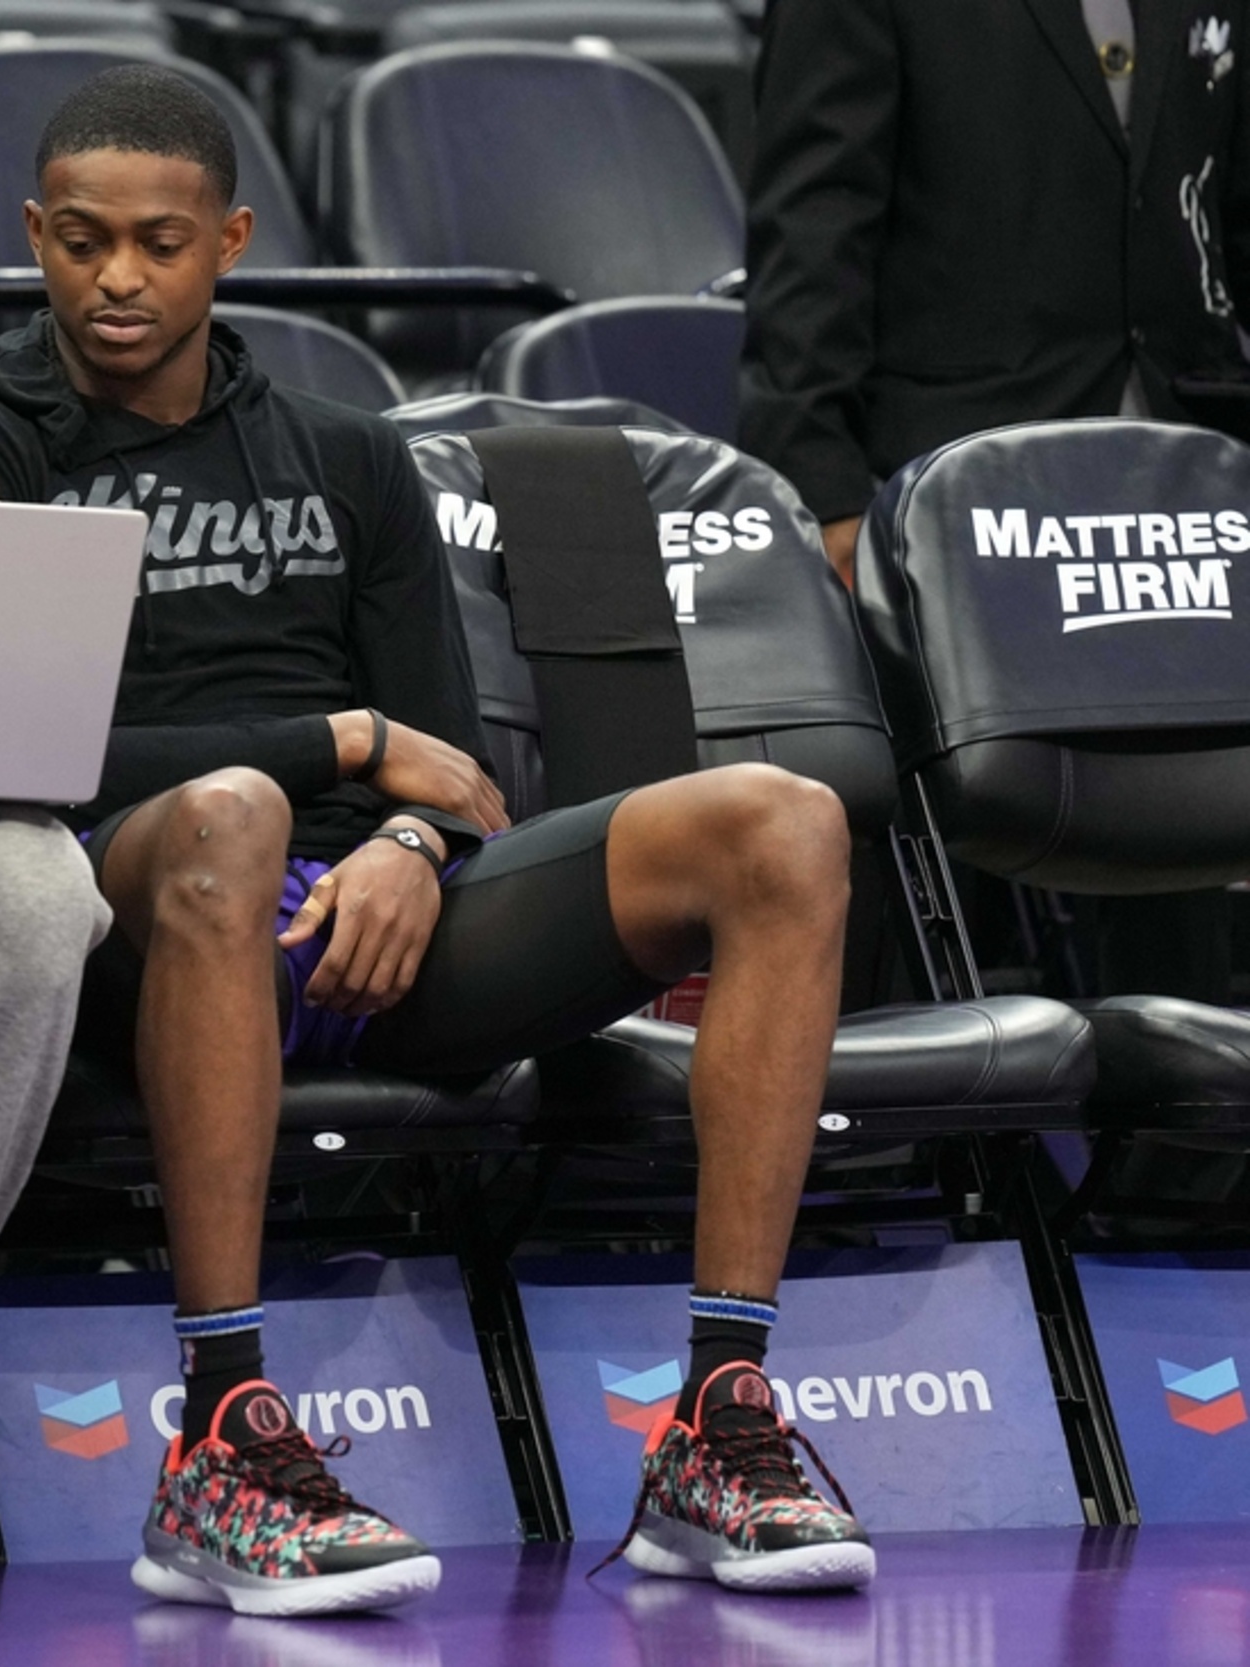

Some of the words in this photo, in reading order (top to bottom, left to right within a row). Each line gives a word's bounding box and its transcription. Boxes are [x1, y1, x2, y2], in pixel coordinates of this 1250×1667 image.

[971, 508, 1250, 557] MATTRES
[1057, 559, 1231, 612] FIRM
[150, 1384, 431, 1441] Cvron
